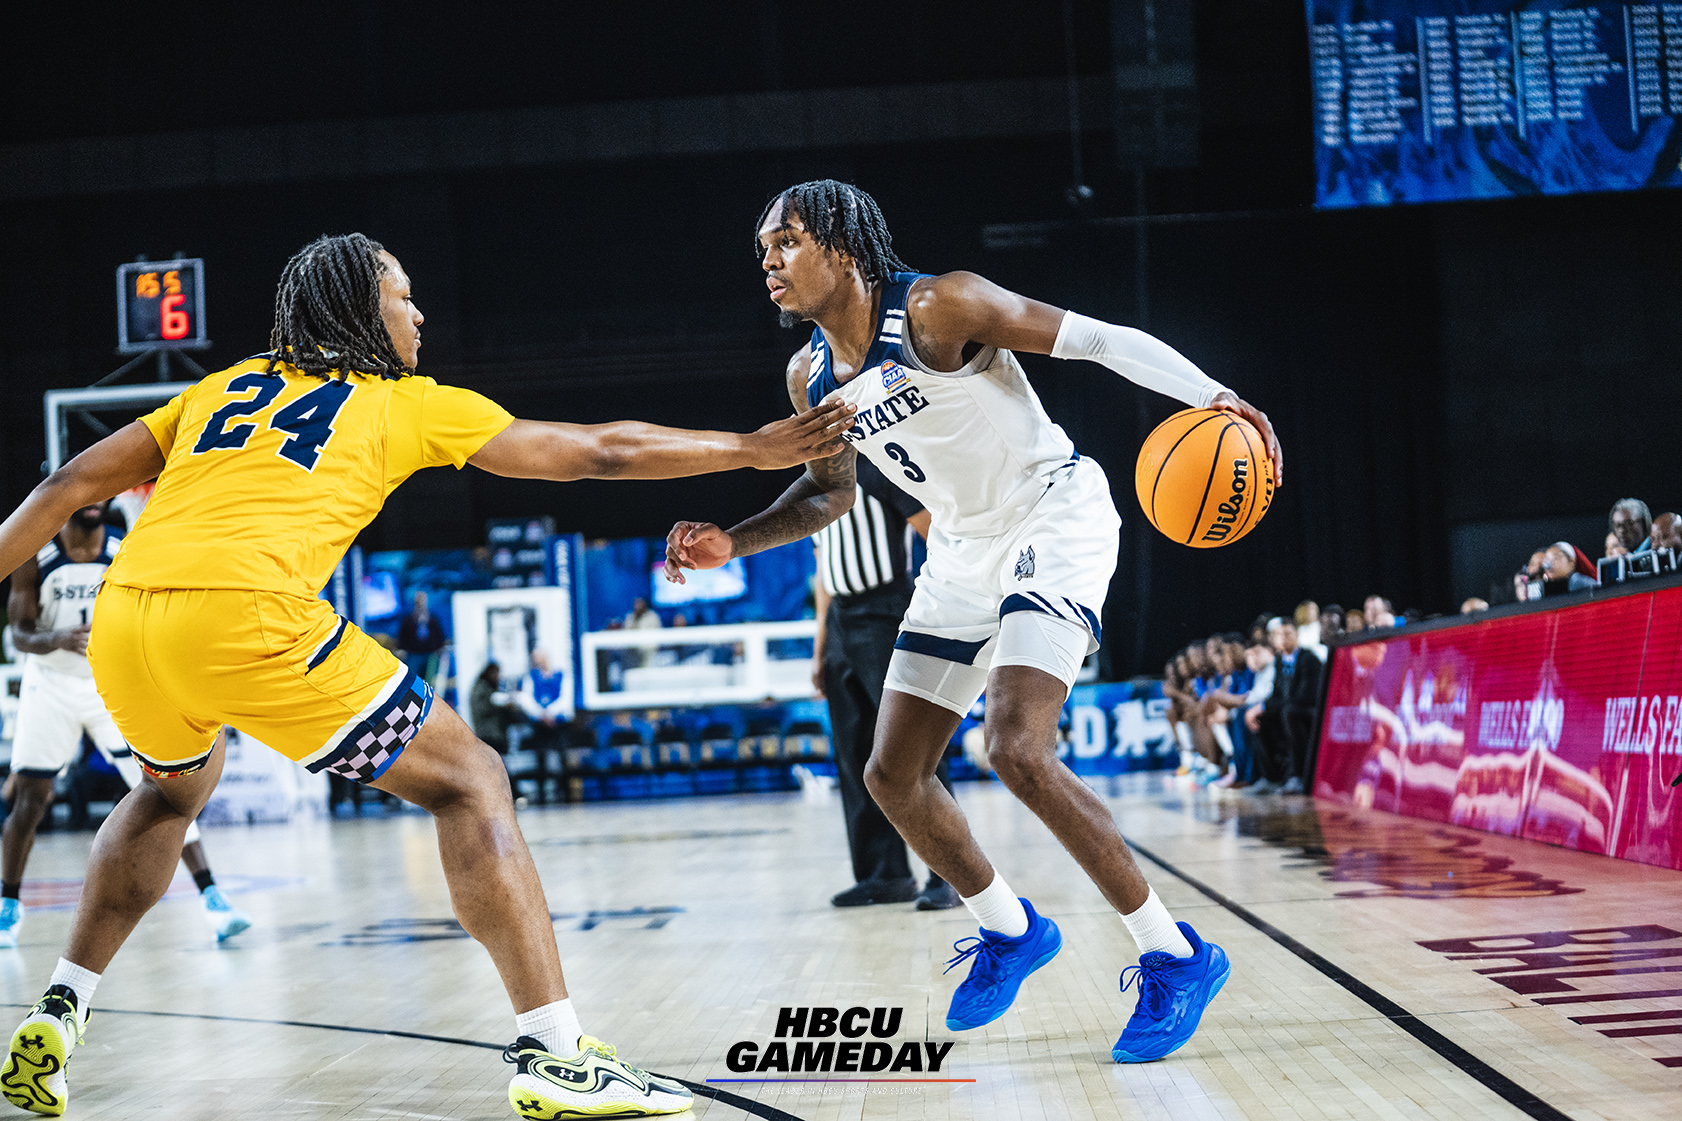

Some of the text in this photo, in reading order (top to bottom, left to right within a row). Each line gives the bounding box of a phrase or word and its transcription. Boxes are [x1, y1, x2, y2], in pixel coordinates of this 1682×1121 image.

[161, 294, 190, 340] 6
[190, 371, 358, 474] 24
[841, 386, 930, 442] STATE
[884, 441, 926, 483] 3
[1202, 458, 1248, 541] Wilson
[79, 607, 88, 625] 1
[1602, 695, 1661, 754] WELLS
